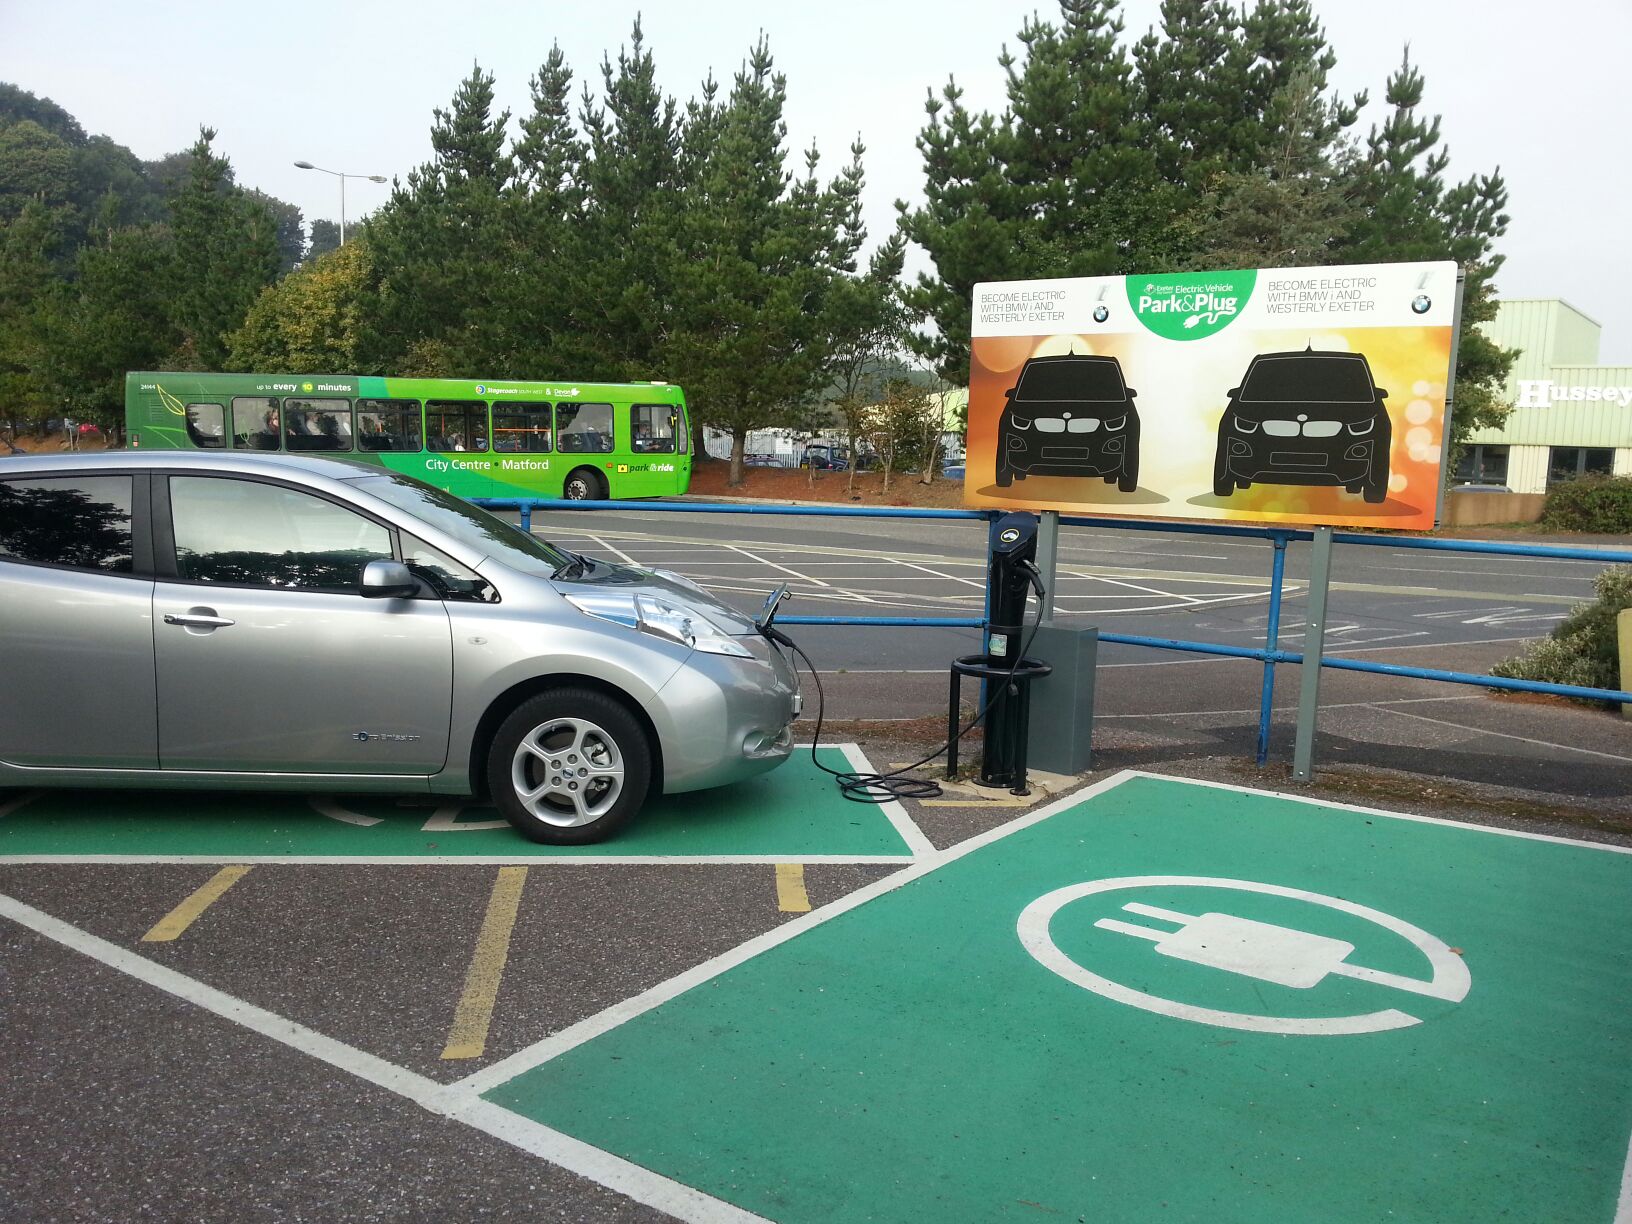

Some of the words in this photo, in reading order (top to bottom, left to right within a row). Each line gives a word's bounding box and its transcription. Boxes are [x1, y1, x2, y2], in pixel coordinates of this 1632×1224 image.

[1175, 285, 1204, 293] Electric
[1205, 284, 1233, 292] Vehicle
[1268, 280, 1317, 291] BECOME
[1321, 278, 1377, 289] ELECTRIC
[981, 292, 1020, 303] BECOME
[1022, 291, 1066, 301] ELECTRIC
[1268, 292, 1296, 302] WITH
[1300, 291, 1328, 301] BMW
[1336, 290, 1361, 300] AND
[981, 304, 1003, 312] WITH
[1006, 302, 1028, 312] BMW
[1034, 302, 1053, 311] AND
[1139, 293, 1238, 315] Park&Plug
[1266, 302, 1326, 314] WESTERLY
[1329, 301, 1375, 312] EXETER
[981, 313, 1027, 323] WESTERLY
[1029, 312, 1064, 321] EXETER
[273, 384, 297, 392] every
[318, 383, 351, 391] minutes
[1516, 380, 1632, 407] Hussey
[426, 459, 449, 472] City
[452, 459, 490, 470] Centre
[502, 459, 549, 470] Matford
